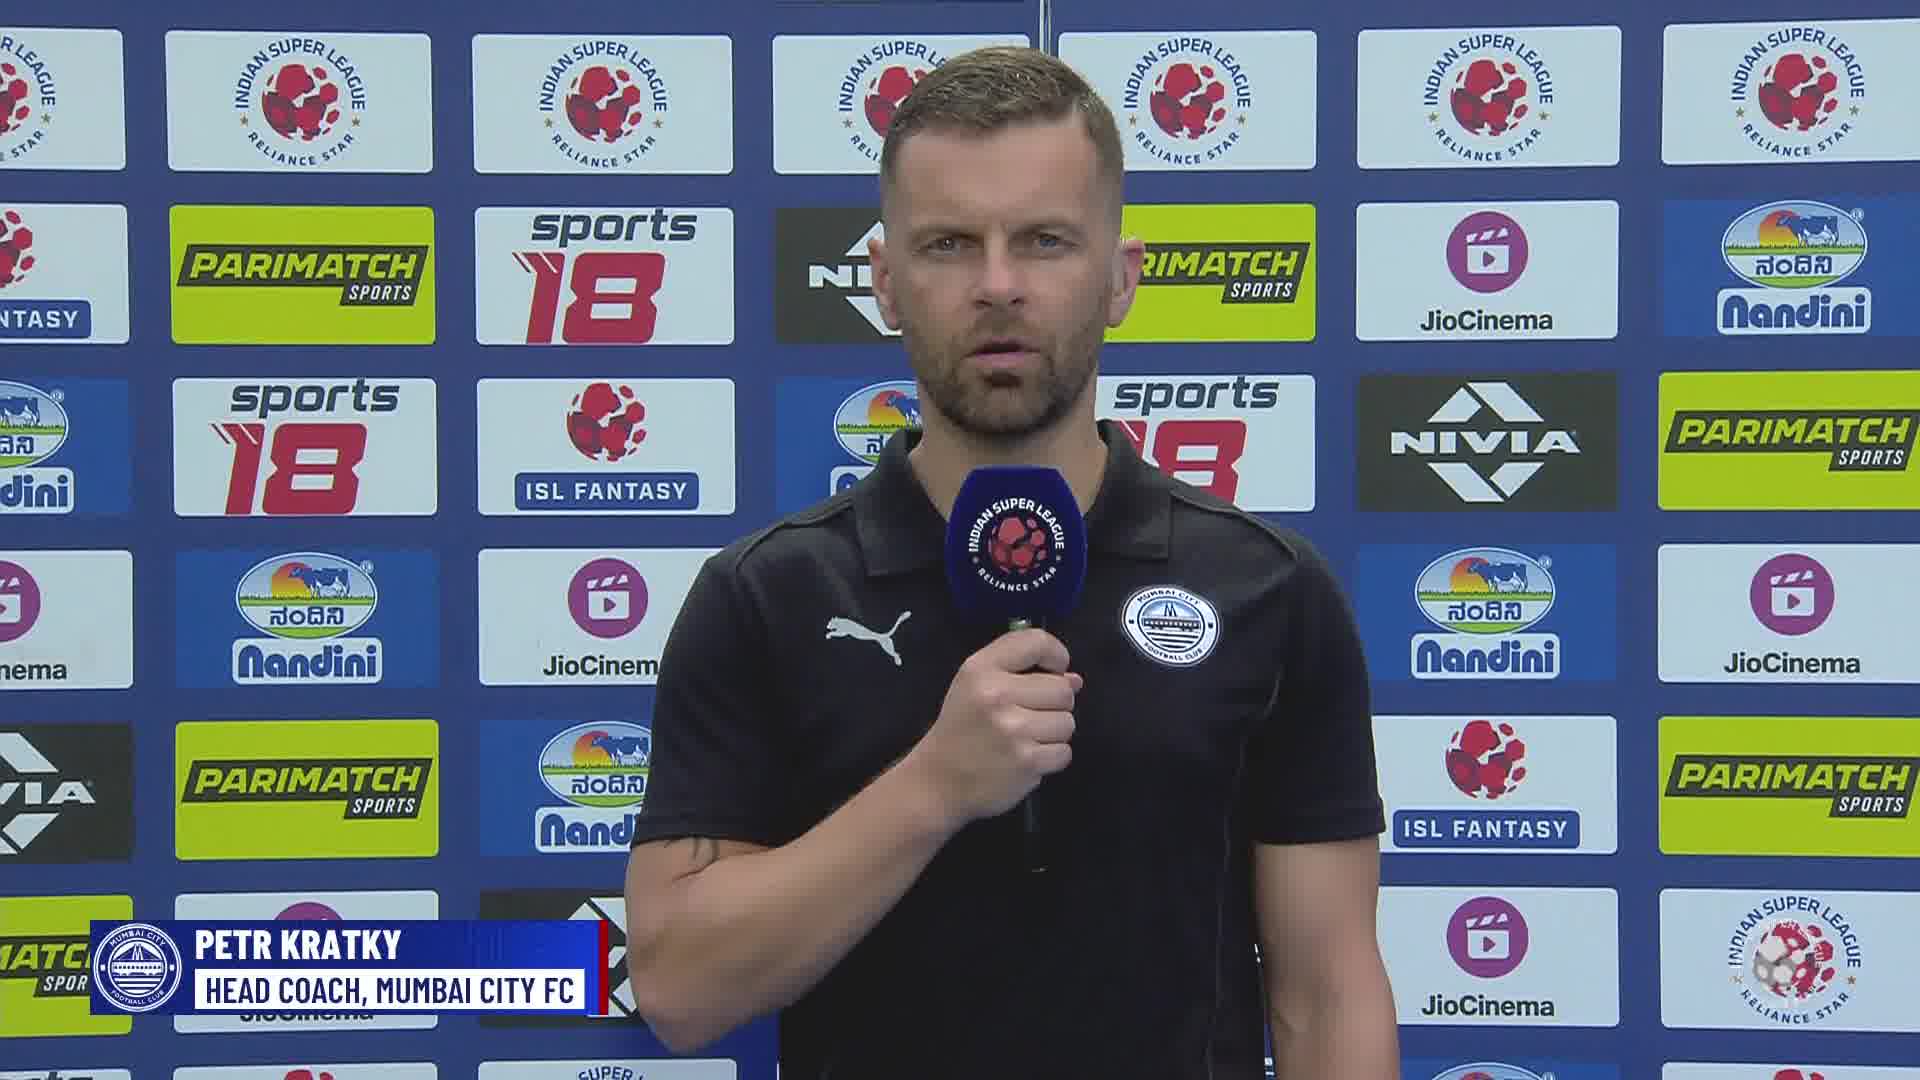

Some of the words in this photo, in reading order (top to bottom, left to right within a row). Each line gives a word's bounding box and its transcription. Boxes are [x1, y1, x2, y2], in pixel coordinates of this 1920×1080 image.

[15, 42, 55, 106] LEAGUE
[235, 51, 270, 109] INDIAN
[268, 39, 325, 58] SUPER
[327, 48, 365, 110] LEAGUE
[540, 54, 573, 111] INDIAN
[573, 41, 628, 60] SUPER
[629, 51, 667, 111] LEAGUE
[839, 54, 872, 112] INDIAN
[872, 41, 927, 60] SUPER
[1124, 51, 1158, 108] INDIAN
[1157, 38, 1213, 58] SUPER
[1213, 47, 1250, 108] LEAGUE
[1424, 48, 1459, 105] INDIAN
[1458, 34, 1514, 54] SUPER
[1516, 43, 1553, 104] LEAGUE
[1731, 41, 1768, 101] INDIAN
[1768, 28, 1825, 48] SUPER
[1826, 36, 1864, 98] LEAGUE
[11, 130, 43, 158] STAR
[248, 132, 316, 165] RELIANCE
[322, 134, 353, 160] STAR
[552, 134, 618, 167] RELIANCE
[624, 135, 656, 162] STAR
[850, 134, 881, 162] RELI
[1136, 131, 1200, 165] RELIANCE
[1207, 132, 1239, 160] STAR
[1435, 128, 1502, 161] RELIANCE
[1508, 128, 1541, 156] STAR
[1743, 123, 1810, 157] RELIANCE
[1818, 122, 1850, 151] STAR
[531, 208, 698, 248] sports
[189, 252, 418, 280] PARIMATCH
[349, 285, 412, 301] SPORTS
[511, 250, 666, 344] 18
[1230, 282, 1293, 298] SPORTS
[0, 310, 79, 329] NTASY
[1421, 310, 1553, 331] JioCinema
[1722, 295, 1866, 328] Nandini
[230, 379, 400, 418] sports
[1113, 376, 1279, 416] sports
[1391, 430, 1581, 454] NIVIA
[1676, 417, 1911, 445] PARIMATCH
[208, 423, 368, 515] 18
[1838, 449, 1904, 465] SPORTS
[0, 473, 68, 507] dini
[526, 483, 564, 501] ISL
[574, 483, 688, 501] FANTASY
[968, 508, 994, 552] INDIAN
[992, 498, 1035, 514] SUPER
[1036, 504, 1064, 549] LEAGUE
[978, 567, 1028, 592] RELIANCE
[1032, 566, 1057, 588] STAR
[238, 645, 376, 678] Nandini
[543, 655, 658, 676] JioCinem
[1416, 639, 1554, 673] Nandini
[1724, 652, 1860, 674] JioCinema
[194, 765, 418, 794] PARIMATCH
[1676, 762, 1911, 790] PARIMATCH
[352, 798, 415, 814] SPORTS
[1838, 797, 1904, 813] SPORTS
[541, 813, 637, 846] Nand
[1403, 819, 1444, 838] ISL
[1453, 820, 1567, 839] FANTASY
[1728, 908, 1764, 966] INDIAN
[1762, 896, 1820, 916] SUPER
[1822, 906, 1861, 968] LEAGUE
[43, 975, 88, 992] SPOR
[1421, 995, 1555, 1018] JioCinema
[1741, 989, 1810, 1024] RELIANCE
[1816, 992, 1848, 1019] STAR
